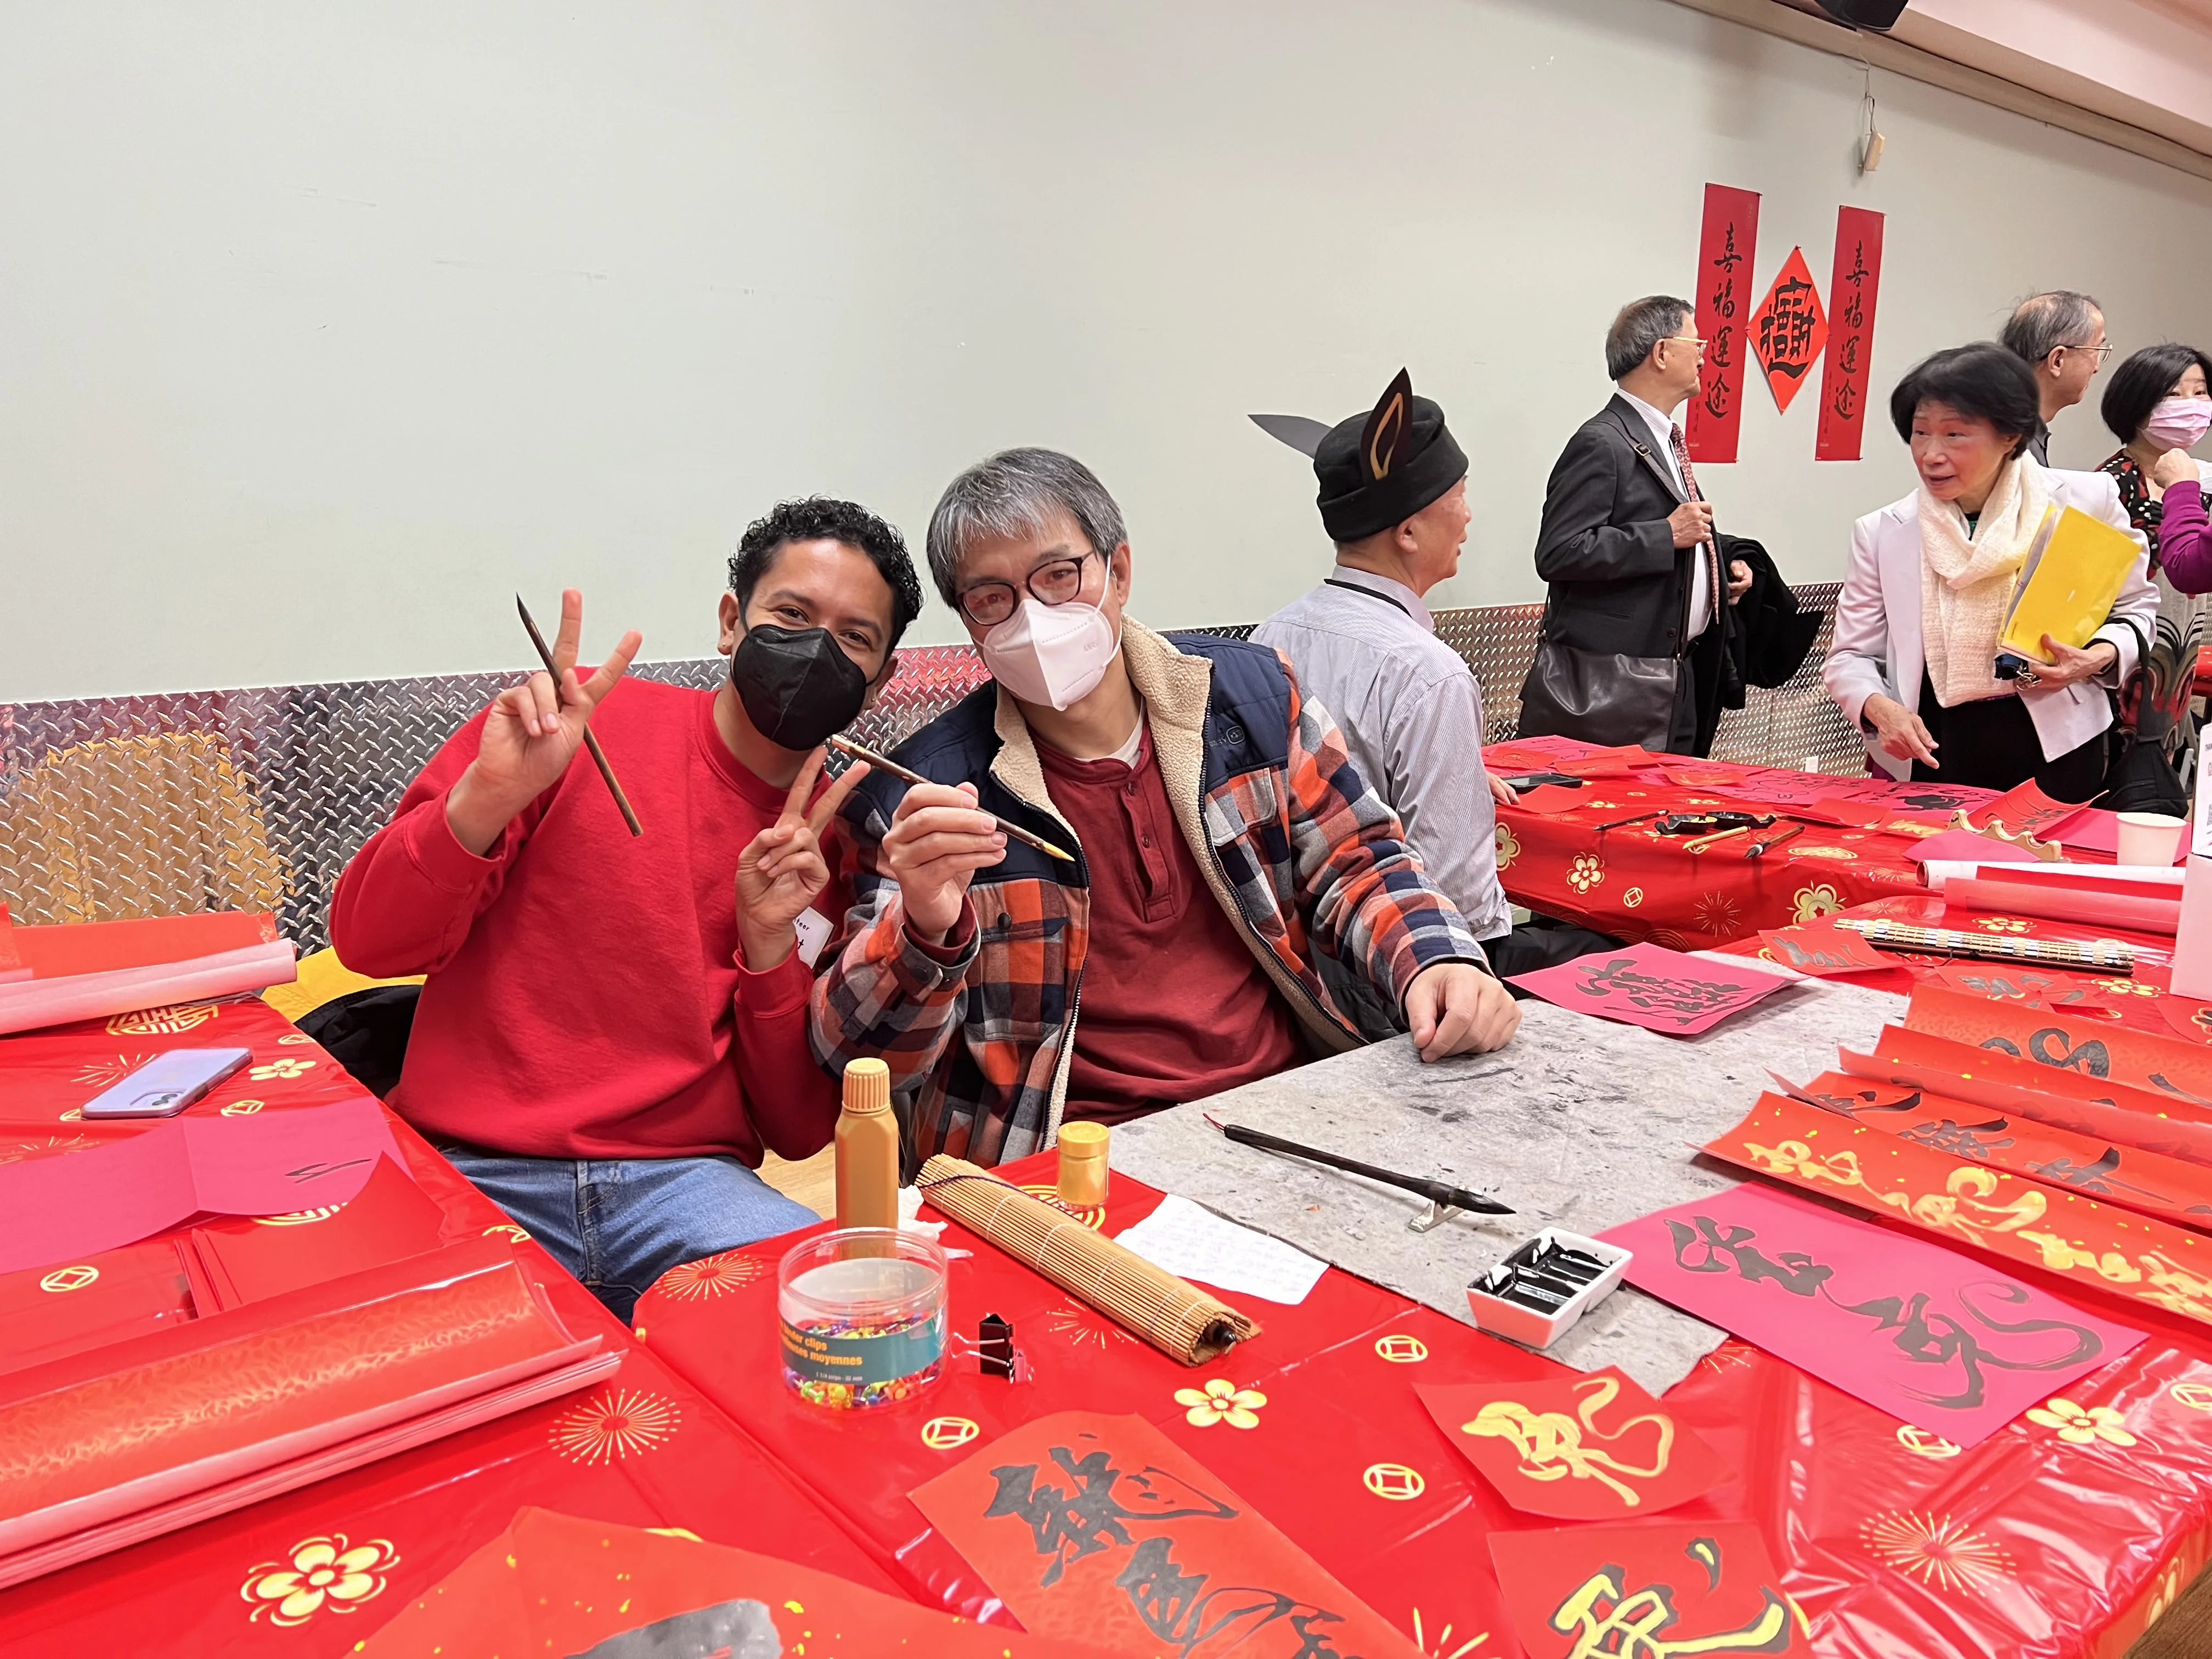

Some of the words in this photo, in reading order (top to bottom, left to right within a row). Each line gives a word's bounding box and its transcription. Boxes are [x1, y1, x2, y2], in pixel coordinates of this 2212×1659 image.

[793, 918, 810, 931] teer
[805, 1337, 827, 1351] clips
[810, 1351, 863, 1366] moyennes
